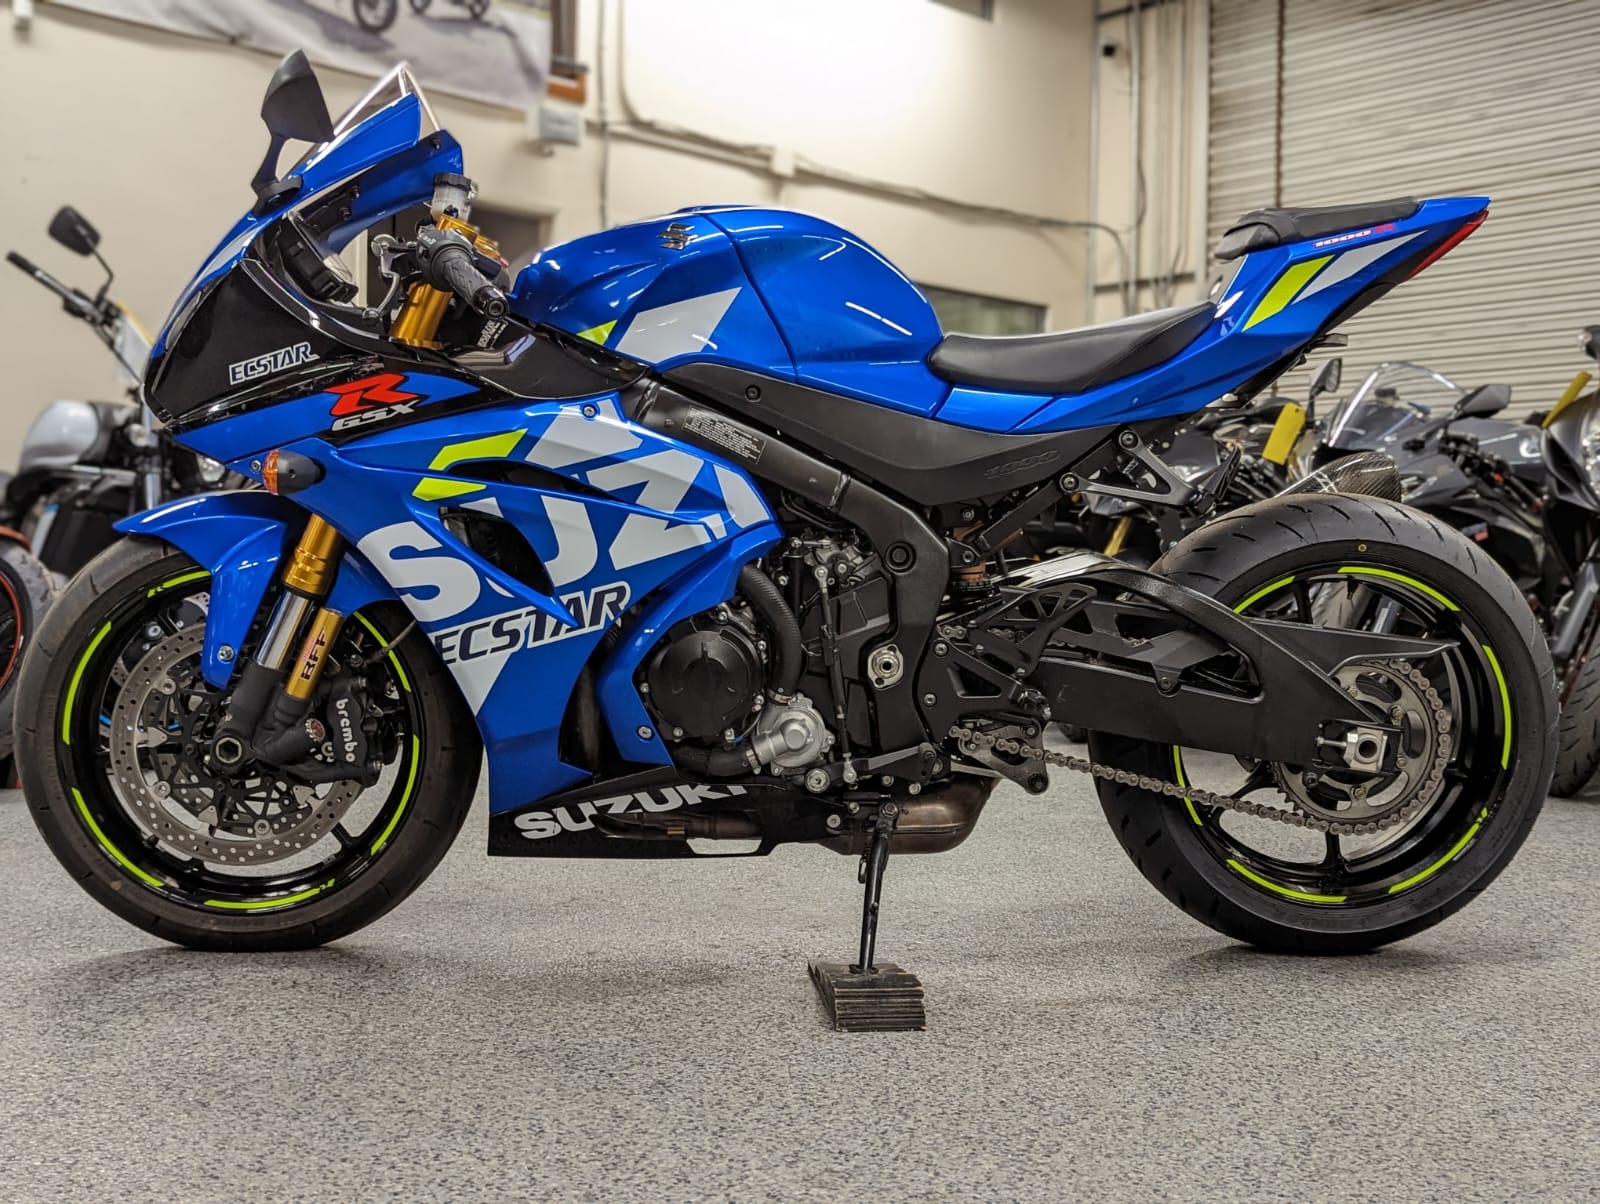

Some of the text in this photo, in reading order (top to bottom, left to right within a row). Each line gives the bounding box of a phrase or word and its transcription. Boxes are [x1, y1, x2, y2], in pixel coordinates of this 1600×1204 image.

[229, 341, 320, 385] ECSTAR
[324, 373, 420, 416] R
[331, 400, 421, 431] GSX
[432, 582, 630, 665] ECSTAR
[336, 698, 358, 762] brembo
